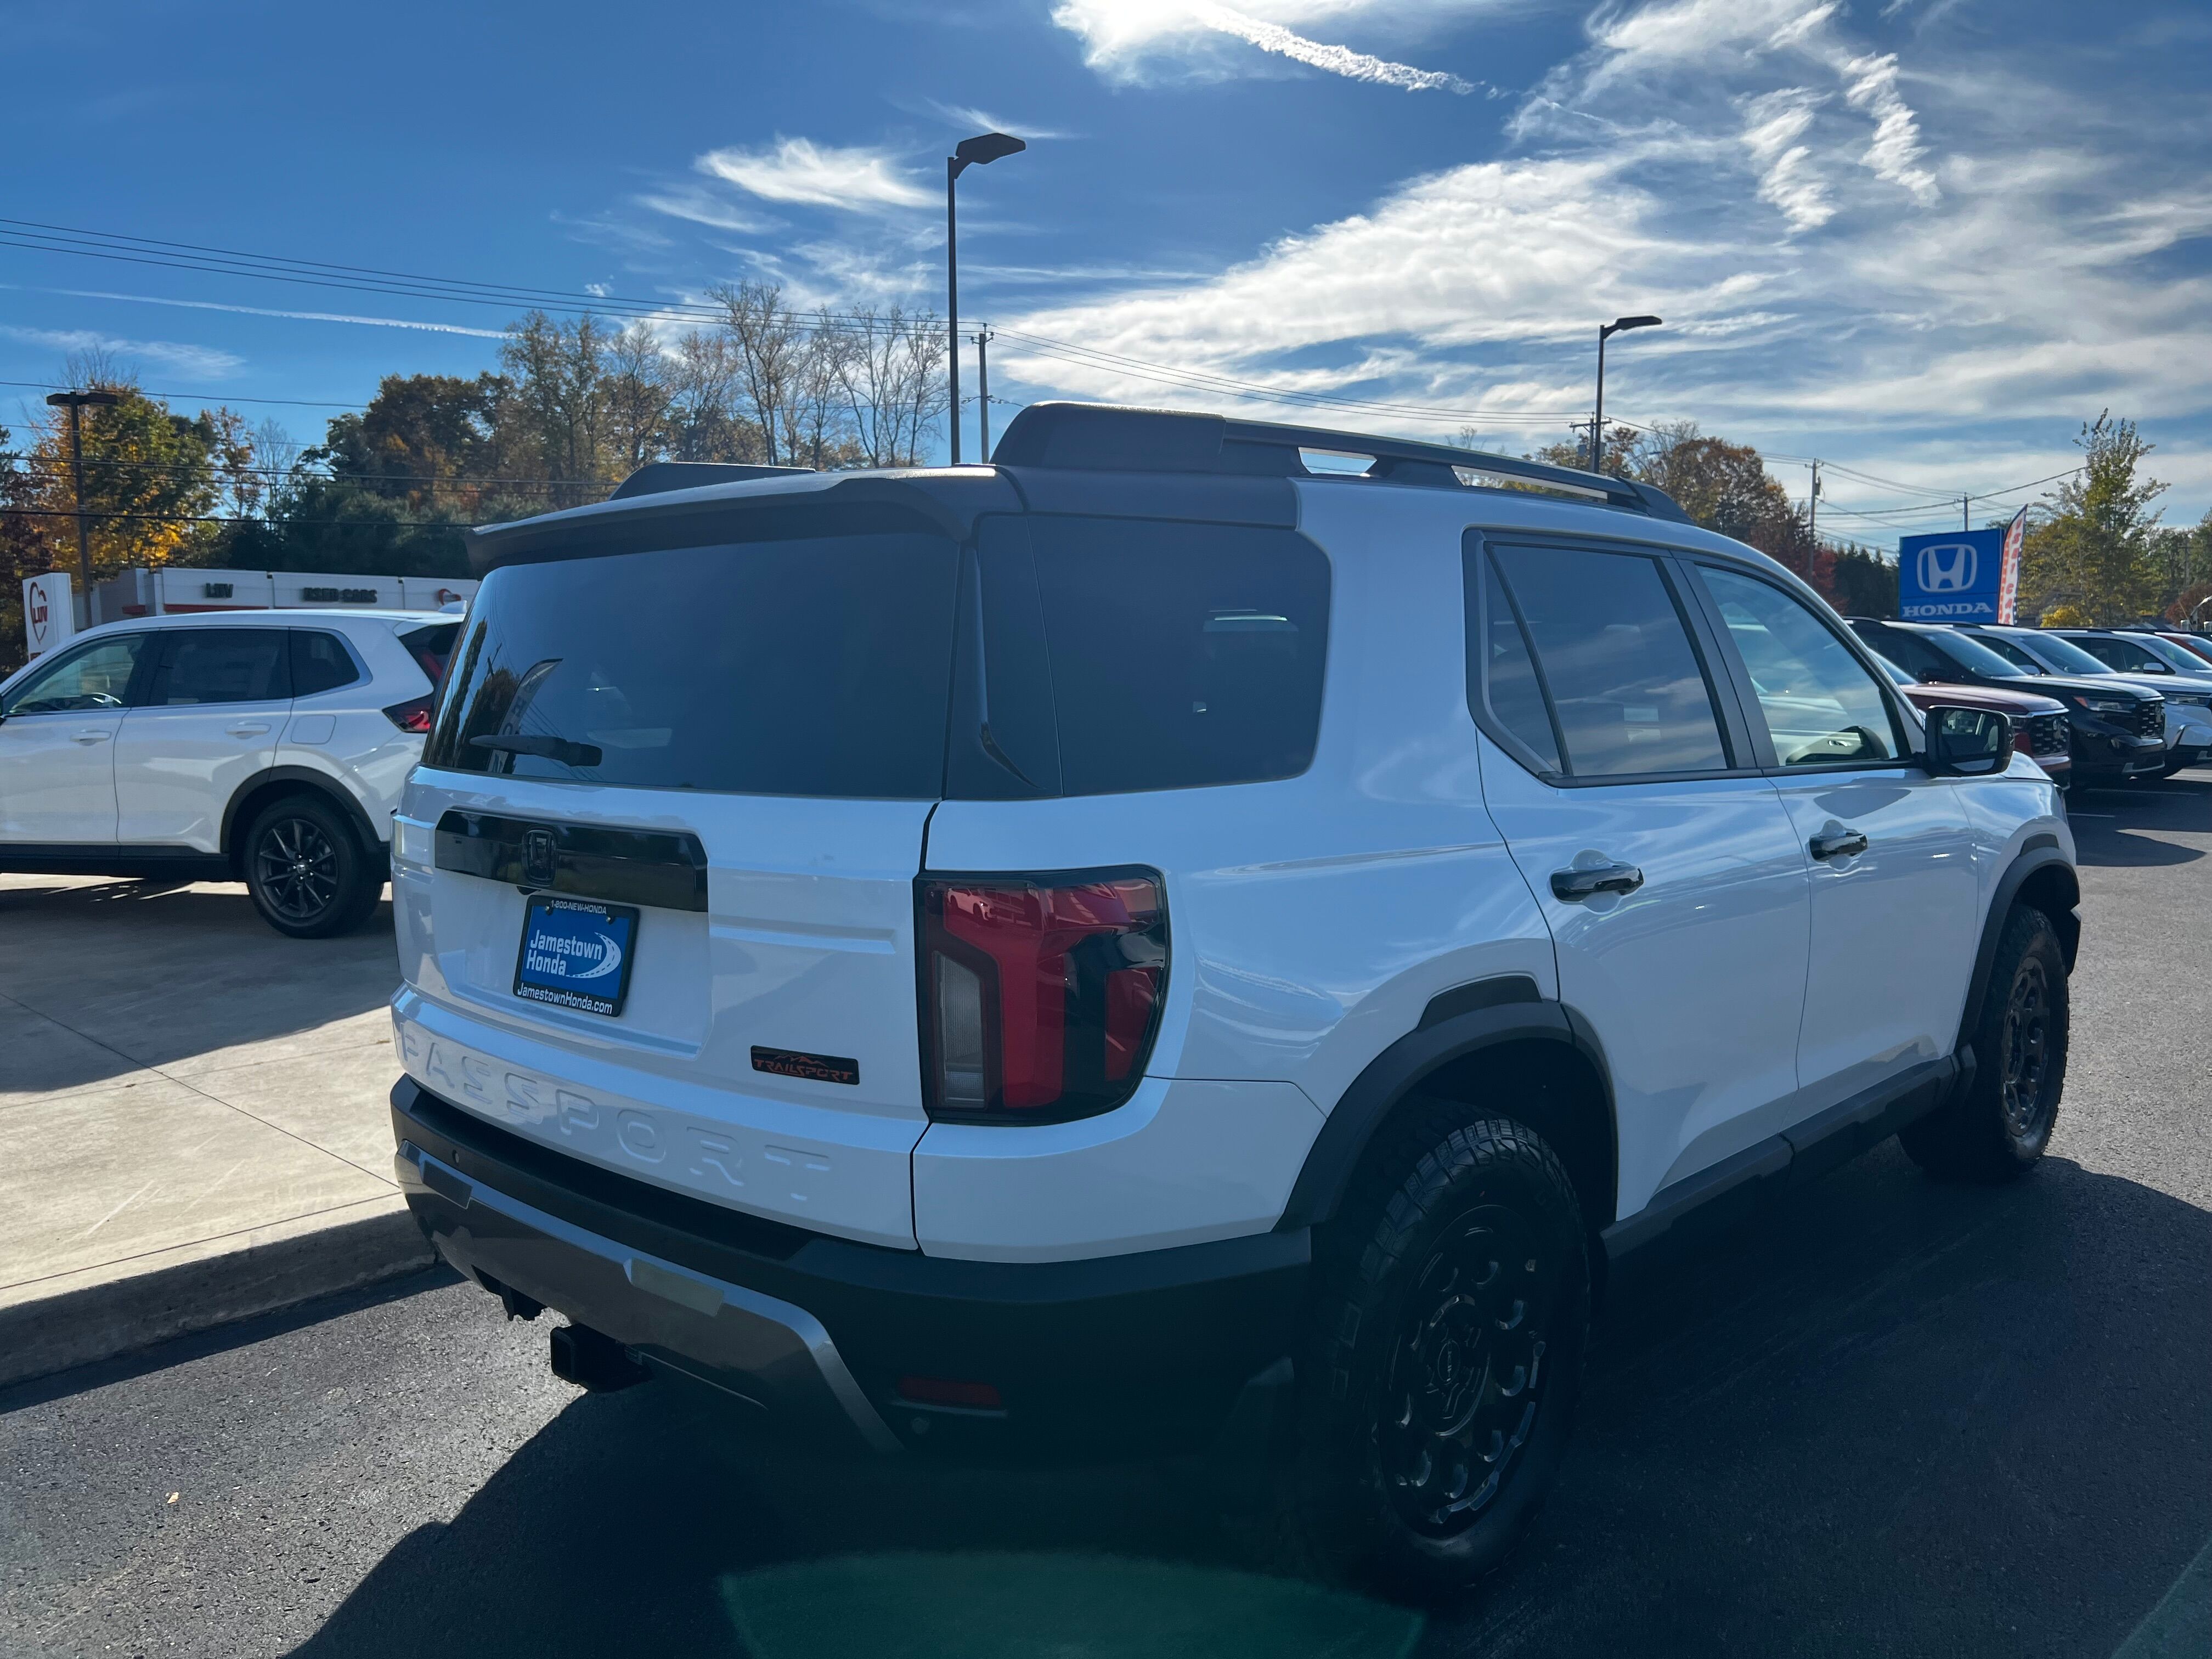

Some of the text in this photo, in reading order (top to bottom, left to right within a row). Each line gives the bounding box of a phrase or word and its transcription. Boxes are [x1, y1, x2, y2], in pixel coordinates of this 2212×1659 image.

[33, 606, 48, 624] LUV
[1903, 602, 1993, 617] HONDA
[551, 900, 607, 915] 1-800-NEW-HONDA
[530, 929, 602, 960] Jamestown
[526, 949, 567, 977] Honda
[517, 983, 612, 1014] JamestownHonda.com
[754, 1059, 853, 1082] TRAILSPORT
[399, 1022, 831, 1201] PASSPORT
